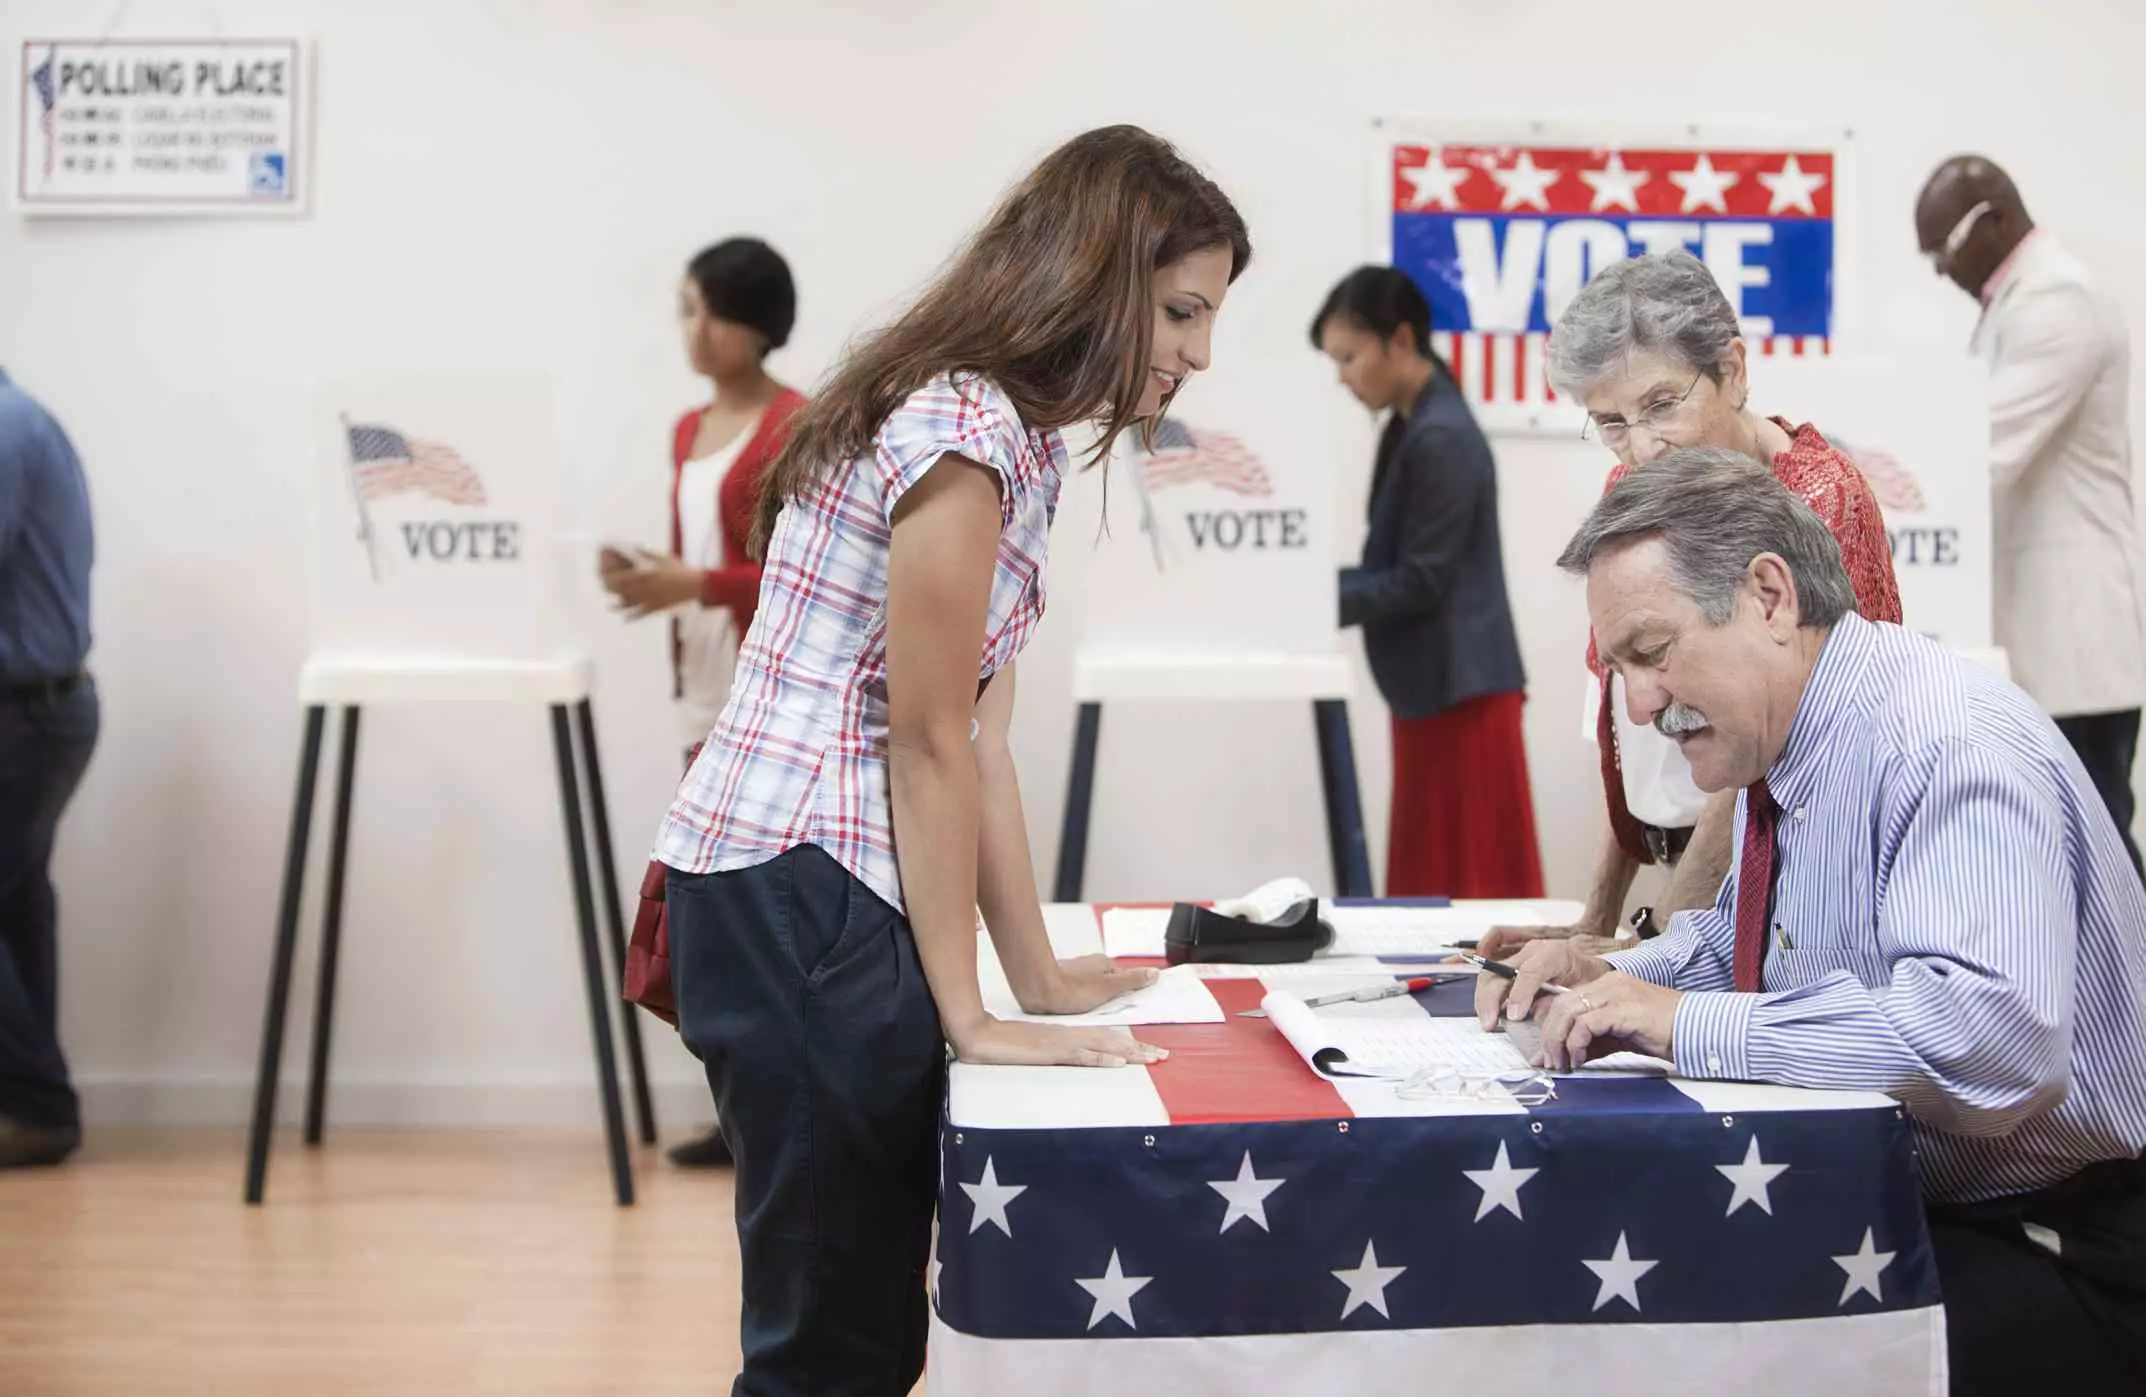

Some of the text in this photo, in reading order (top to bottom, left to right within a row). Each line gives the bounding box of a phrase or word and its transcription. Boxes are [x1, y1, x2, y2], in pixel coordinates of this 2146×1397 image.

[60, 61, 285, 96] POLLING PLACE
[401, 520, 520, 561] VOTE
[1185, 509, 1308, 550] VOTE
